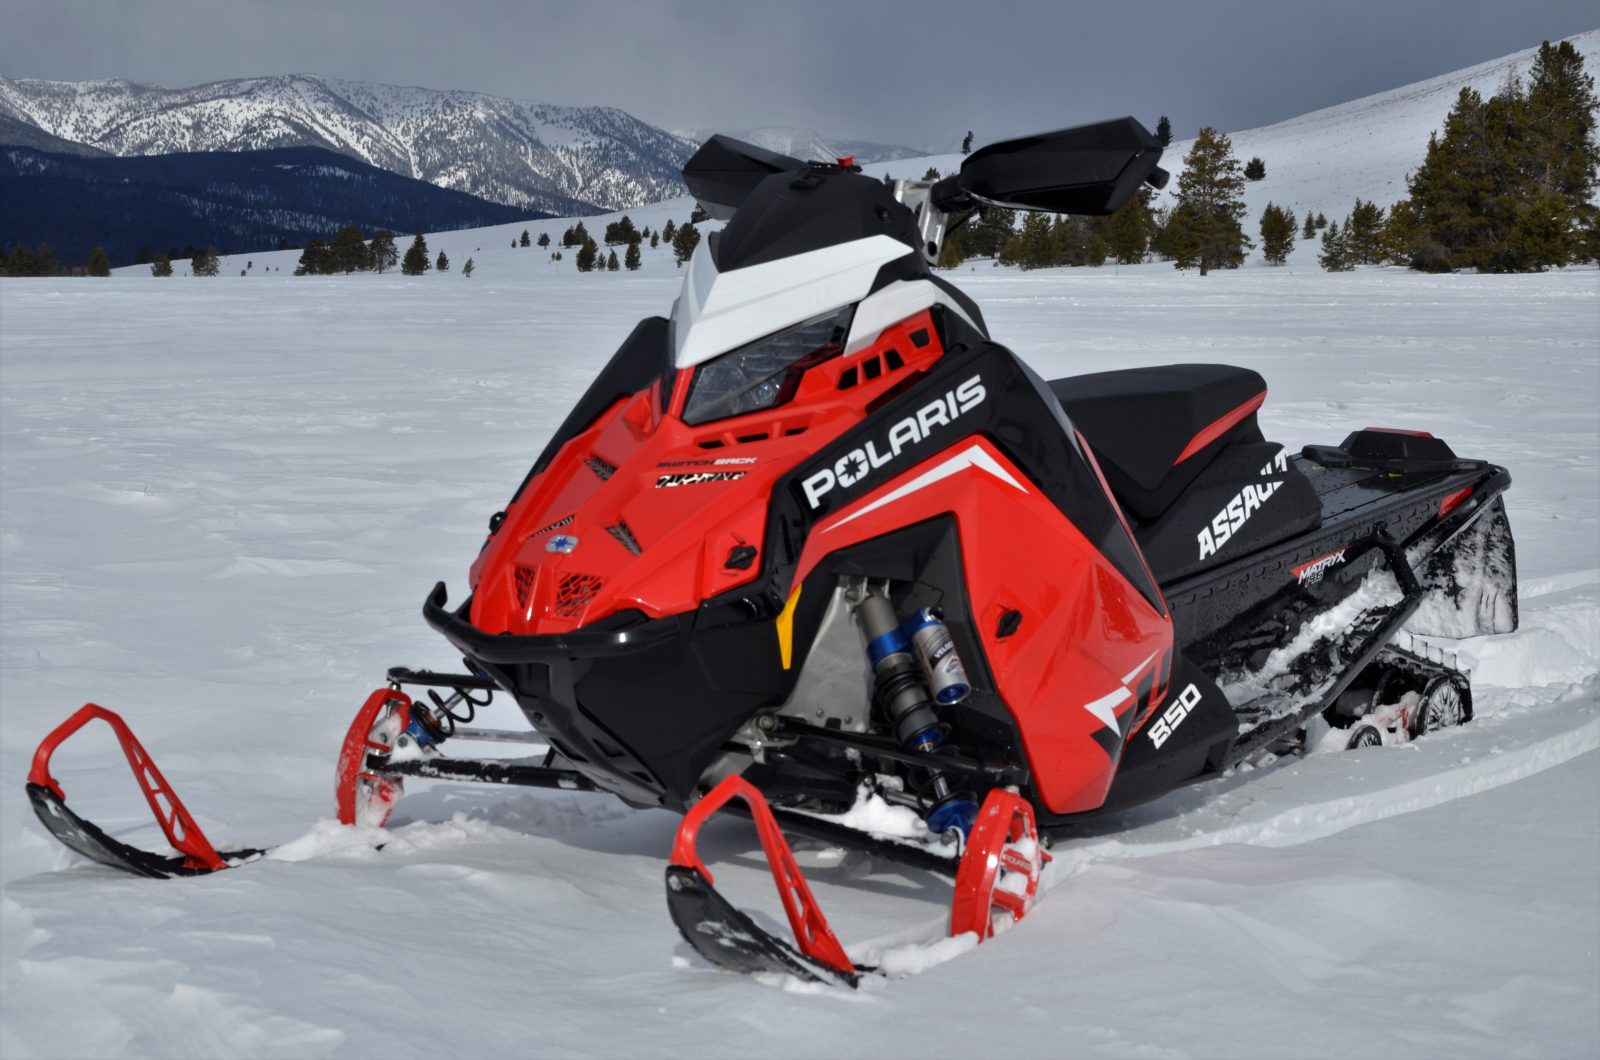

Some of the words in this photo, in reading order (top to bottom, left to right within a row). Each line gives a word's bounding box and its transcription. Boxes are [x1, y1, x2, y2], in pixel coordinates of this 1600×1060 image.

[801, 374, 987, 510] POLARIS
[1197, 447, 1289, 561] ASSAULT
[1298, 549, 1346, 585] MATRYX
[1147, 683, 1202, 750] 850
